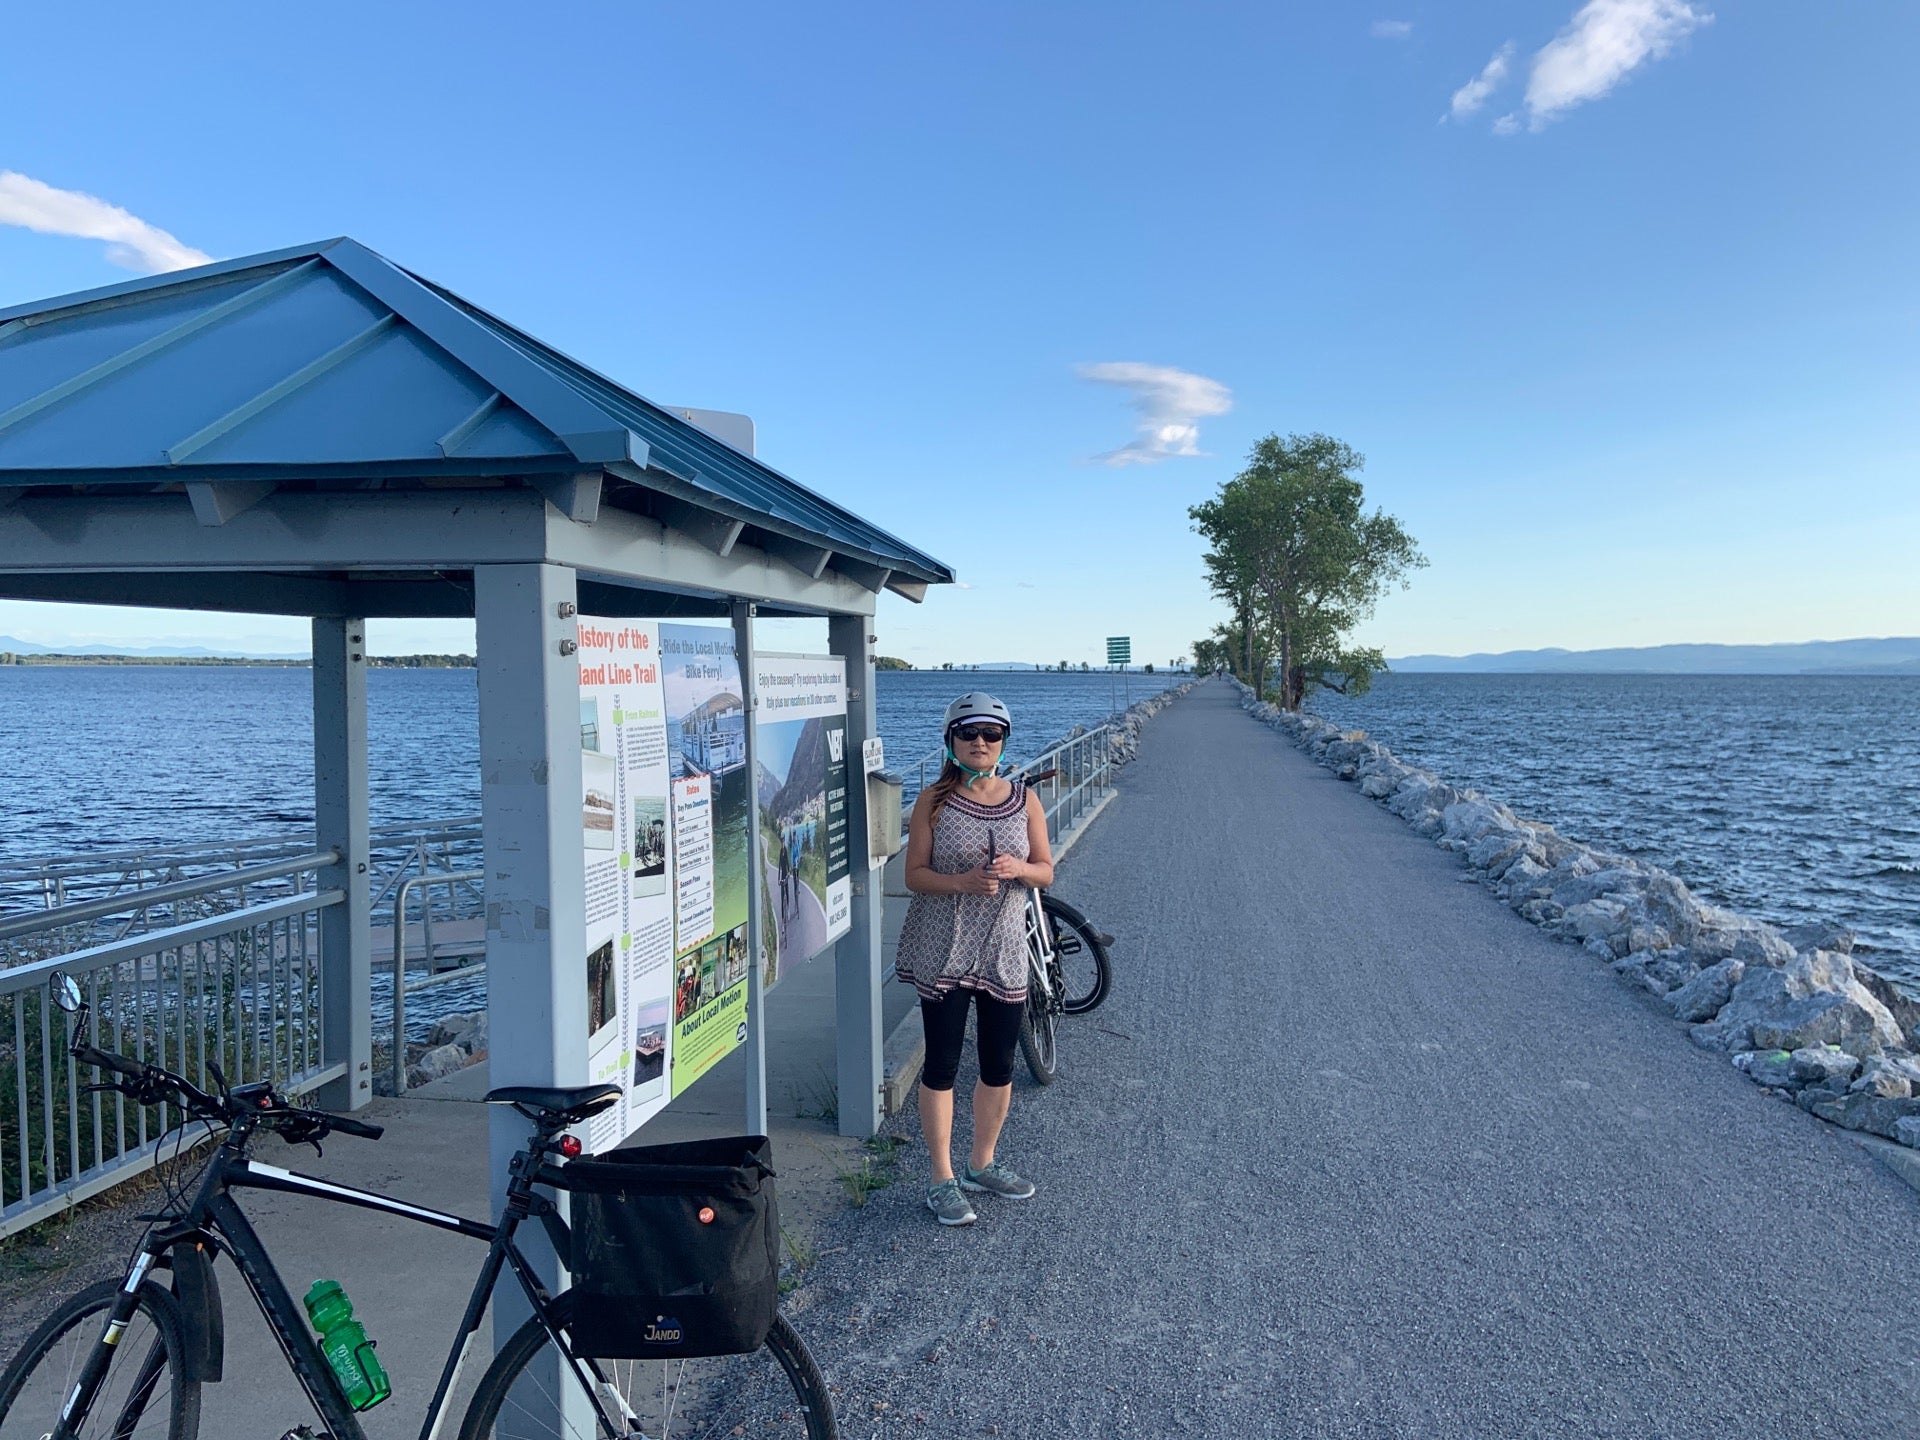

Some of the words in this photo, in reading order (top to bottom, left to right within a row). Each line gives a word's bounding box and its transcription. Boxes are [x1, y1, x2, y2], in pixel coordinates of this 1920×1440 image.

[617, 627, 629, 649] of
[631, 629, 649, 650] the
[663, 639, 681, 655] Ride
[682, 640, 695, 655] the
[695, 640, 714, 656] Local
[714, 641, 736, 657] Motion
[608, 662, 632, 685] Line
[633, 663, 657, 684] Trail
[685, 664, 702, 679] Bike
[703, 664, 723, 682] Ferry!
[759, 672, 769, 688] Enjoy
[826, 728, 844, 762] VBT
[681, 1013, 702, 1039] About
[702, 1000, 719, 1025] Local
[720, 989, 742, 1012] Motion
